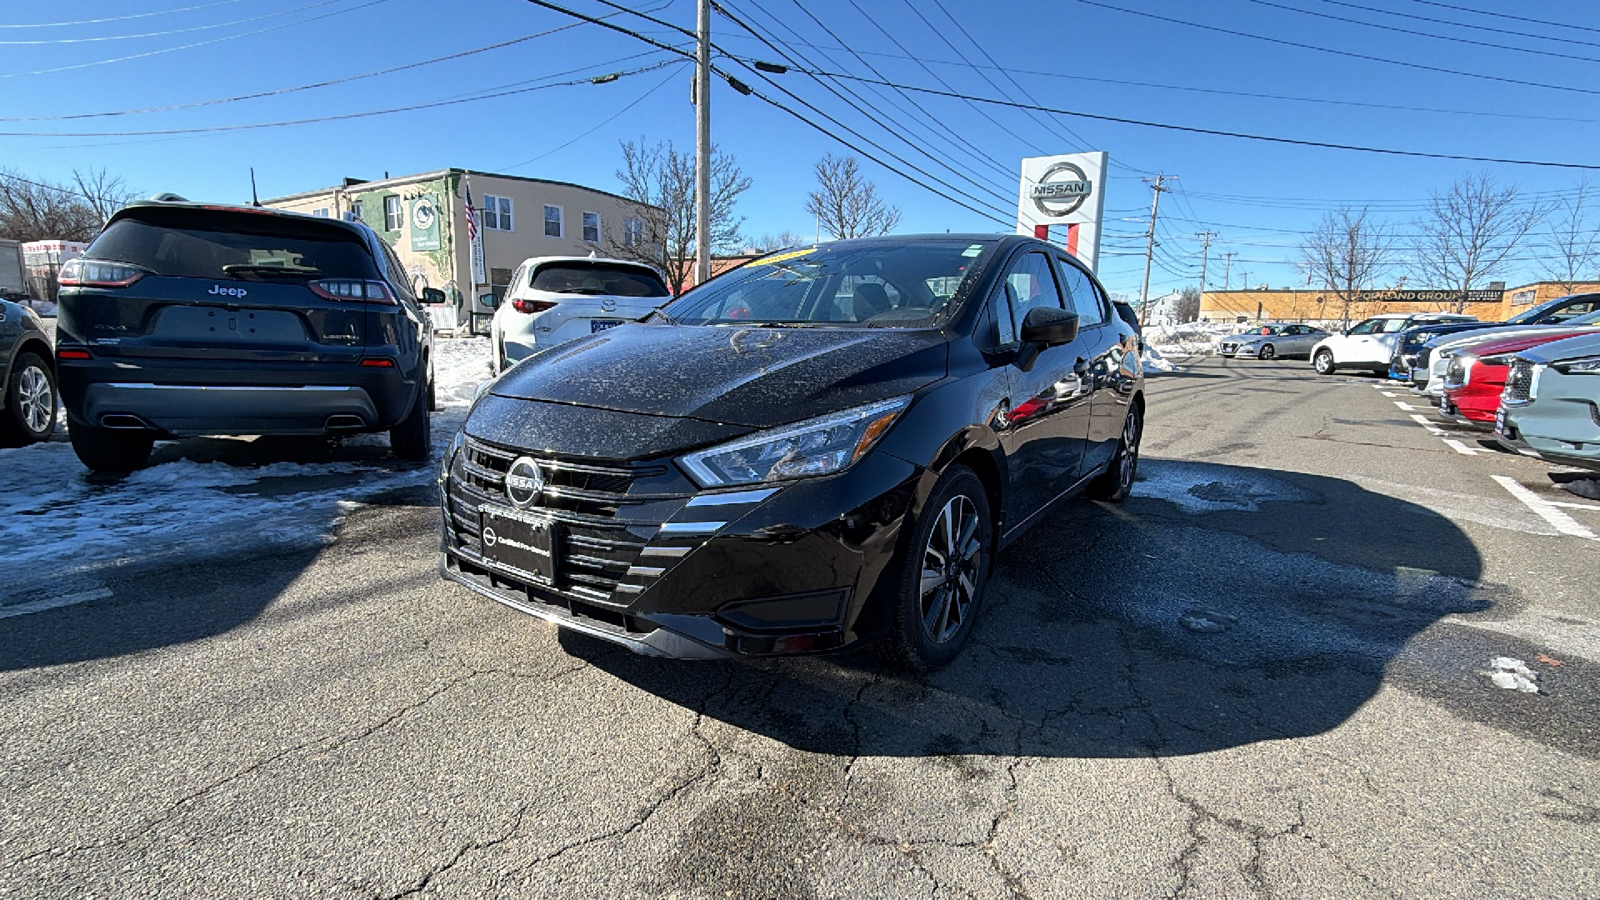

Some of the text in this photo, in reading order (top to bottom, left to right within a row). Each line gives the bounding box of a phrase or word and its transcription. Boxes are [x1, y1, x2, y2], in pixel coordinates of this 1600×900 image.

[1034, 183, 1085, 195] NISSAN
[208, 285, 247, 298] Jeep
[1417, 291, 1460, 300] GROUP
[505, 475, 544, 492] NISSAN
[498, 536, 550, 557] Certified Pre-Owned
